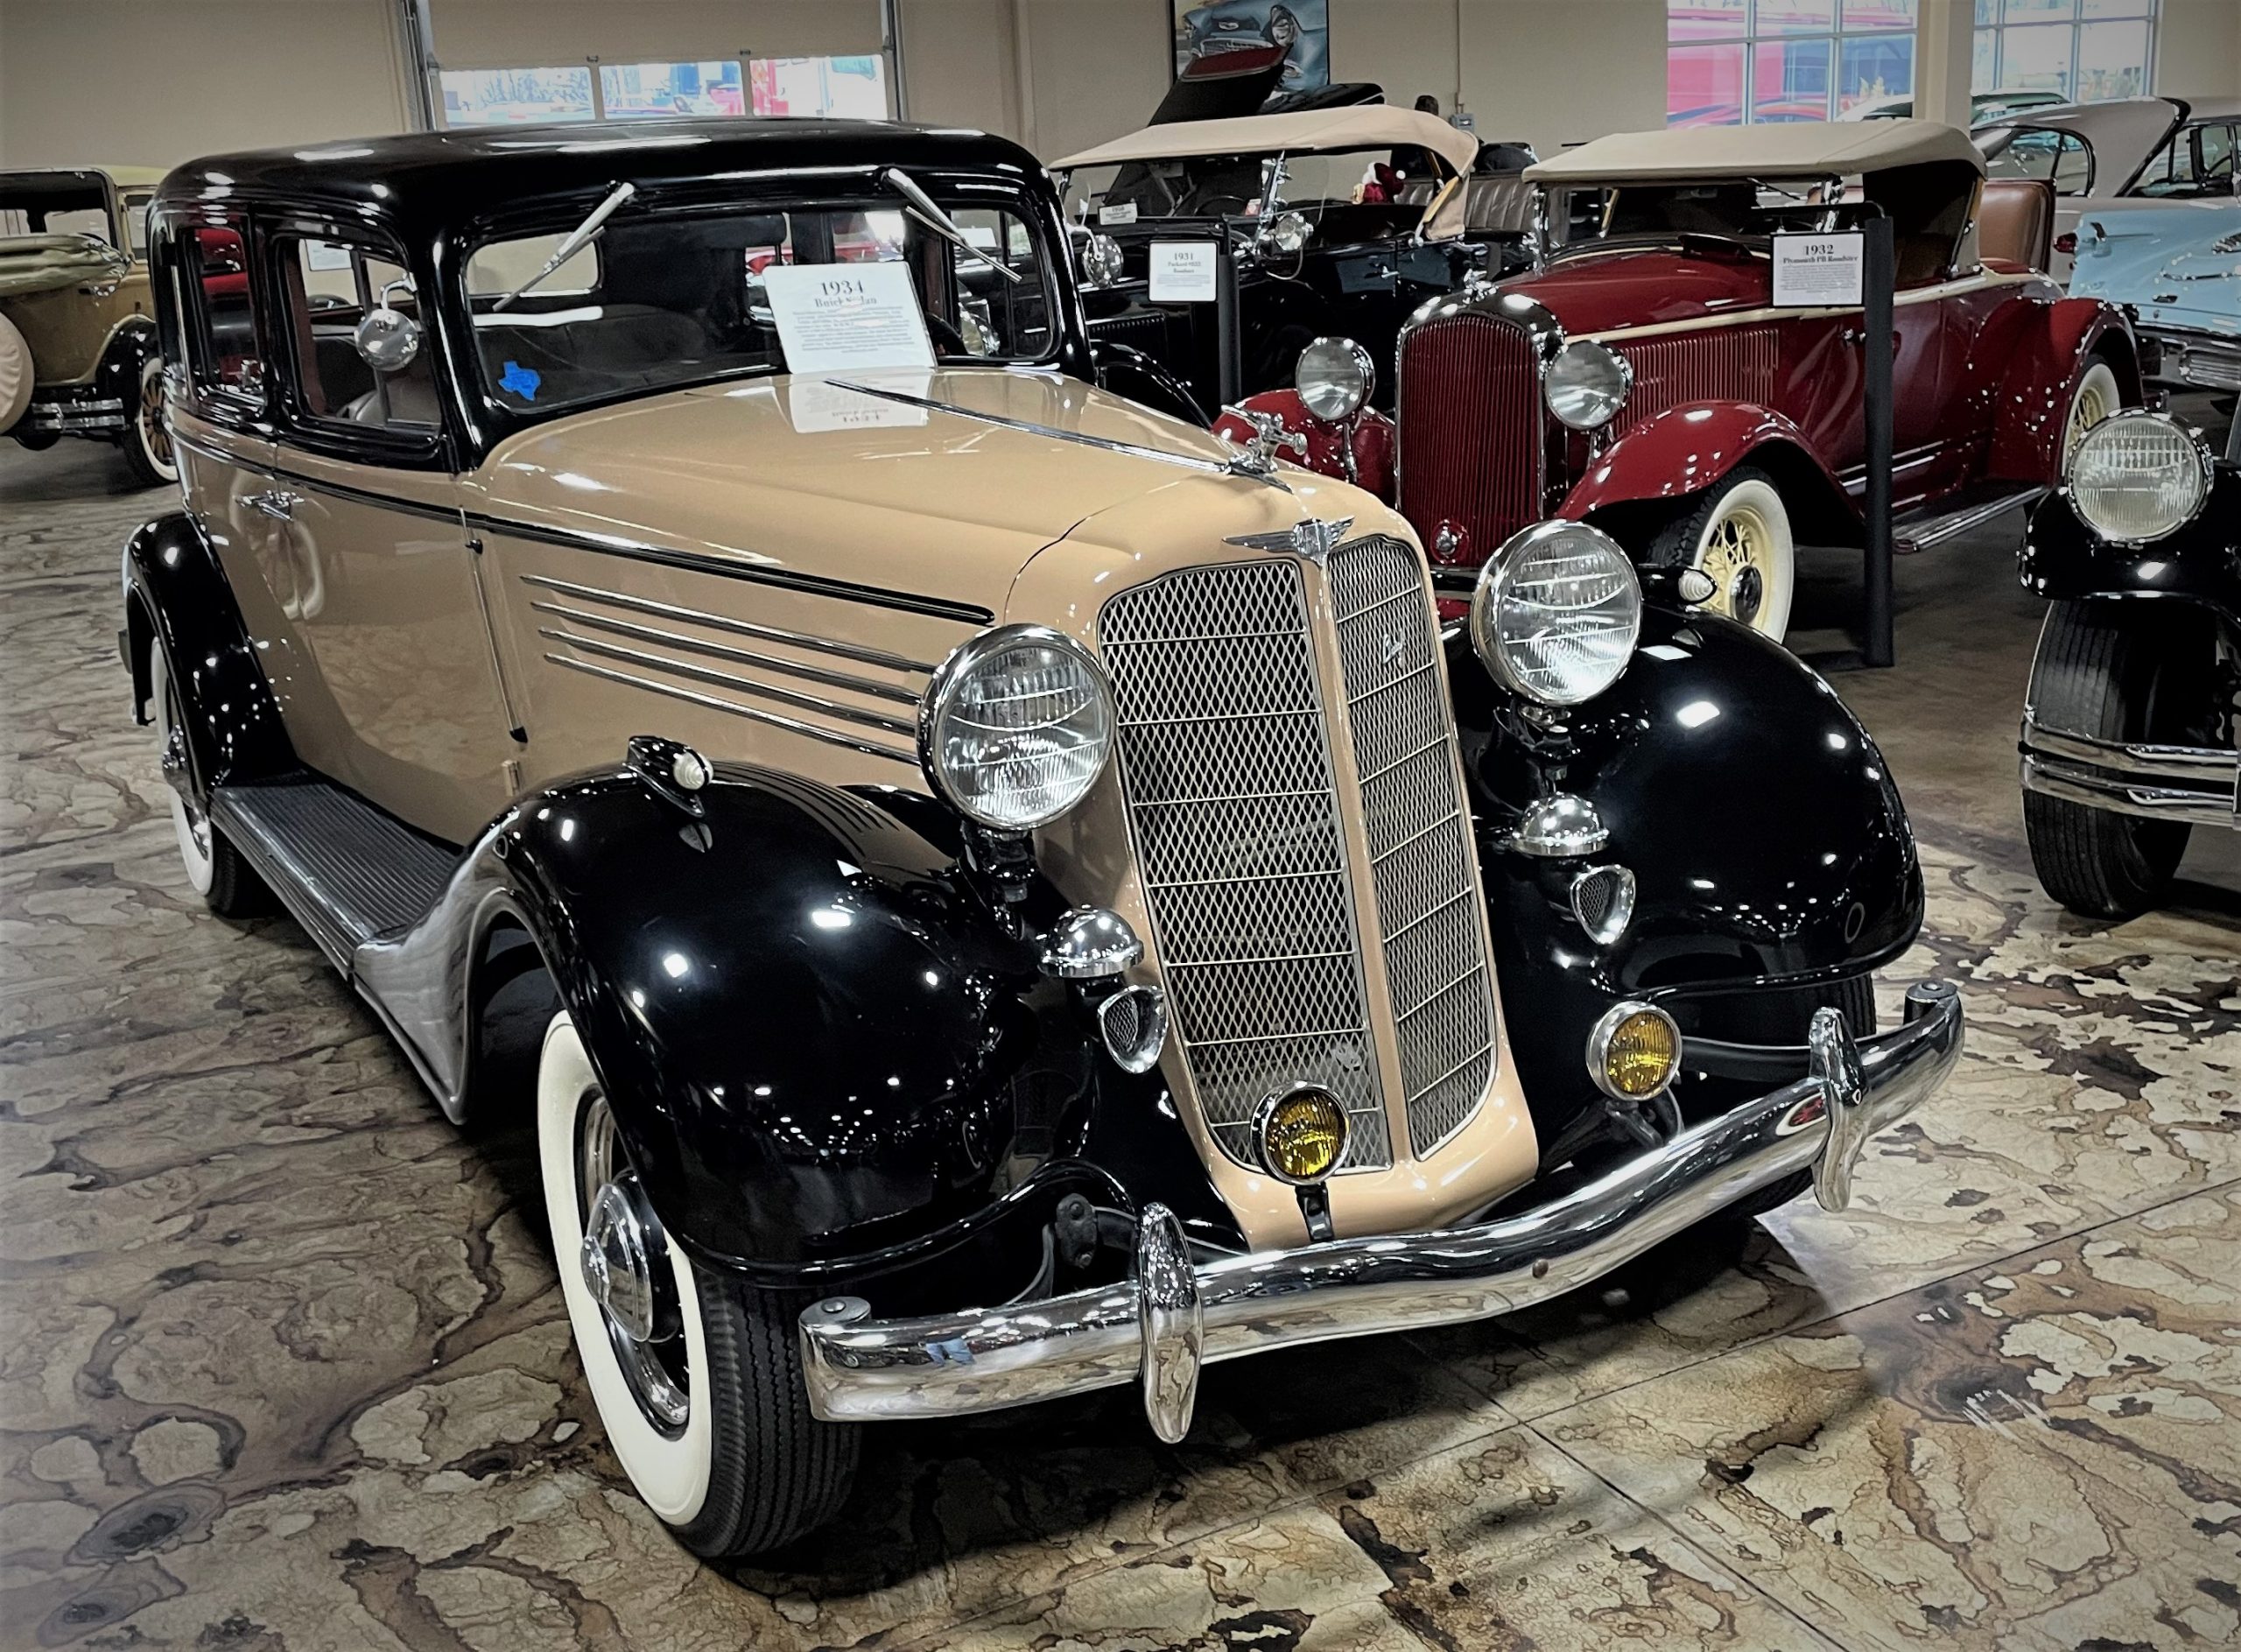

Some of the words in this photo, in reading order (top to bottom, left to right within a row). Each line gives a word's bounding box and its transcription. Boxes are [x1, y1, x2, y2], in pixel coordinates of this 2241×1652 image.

[1804, 244, 1835, 256] 1932
[1174, 252, 1193, 261] 1931
[814, 296, 842, 307] Buick
